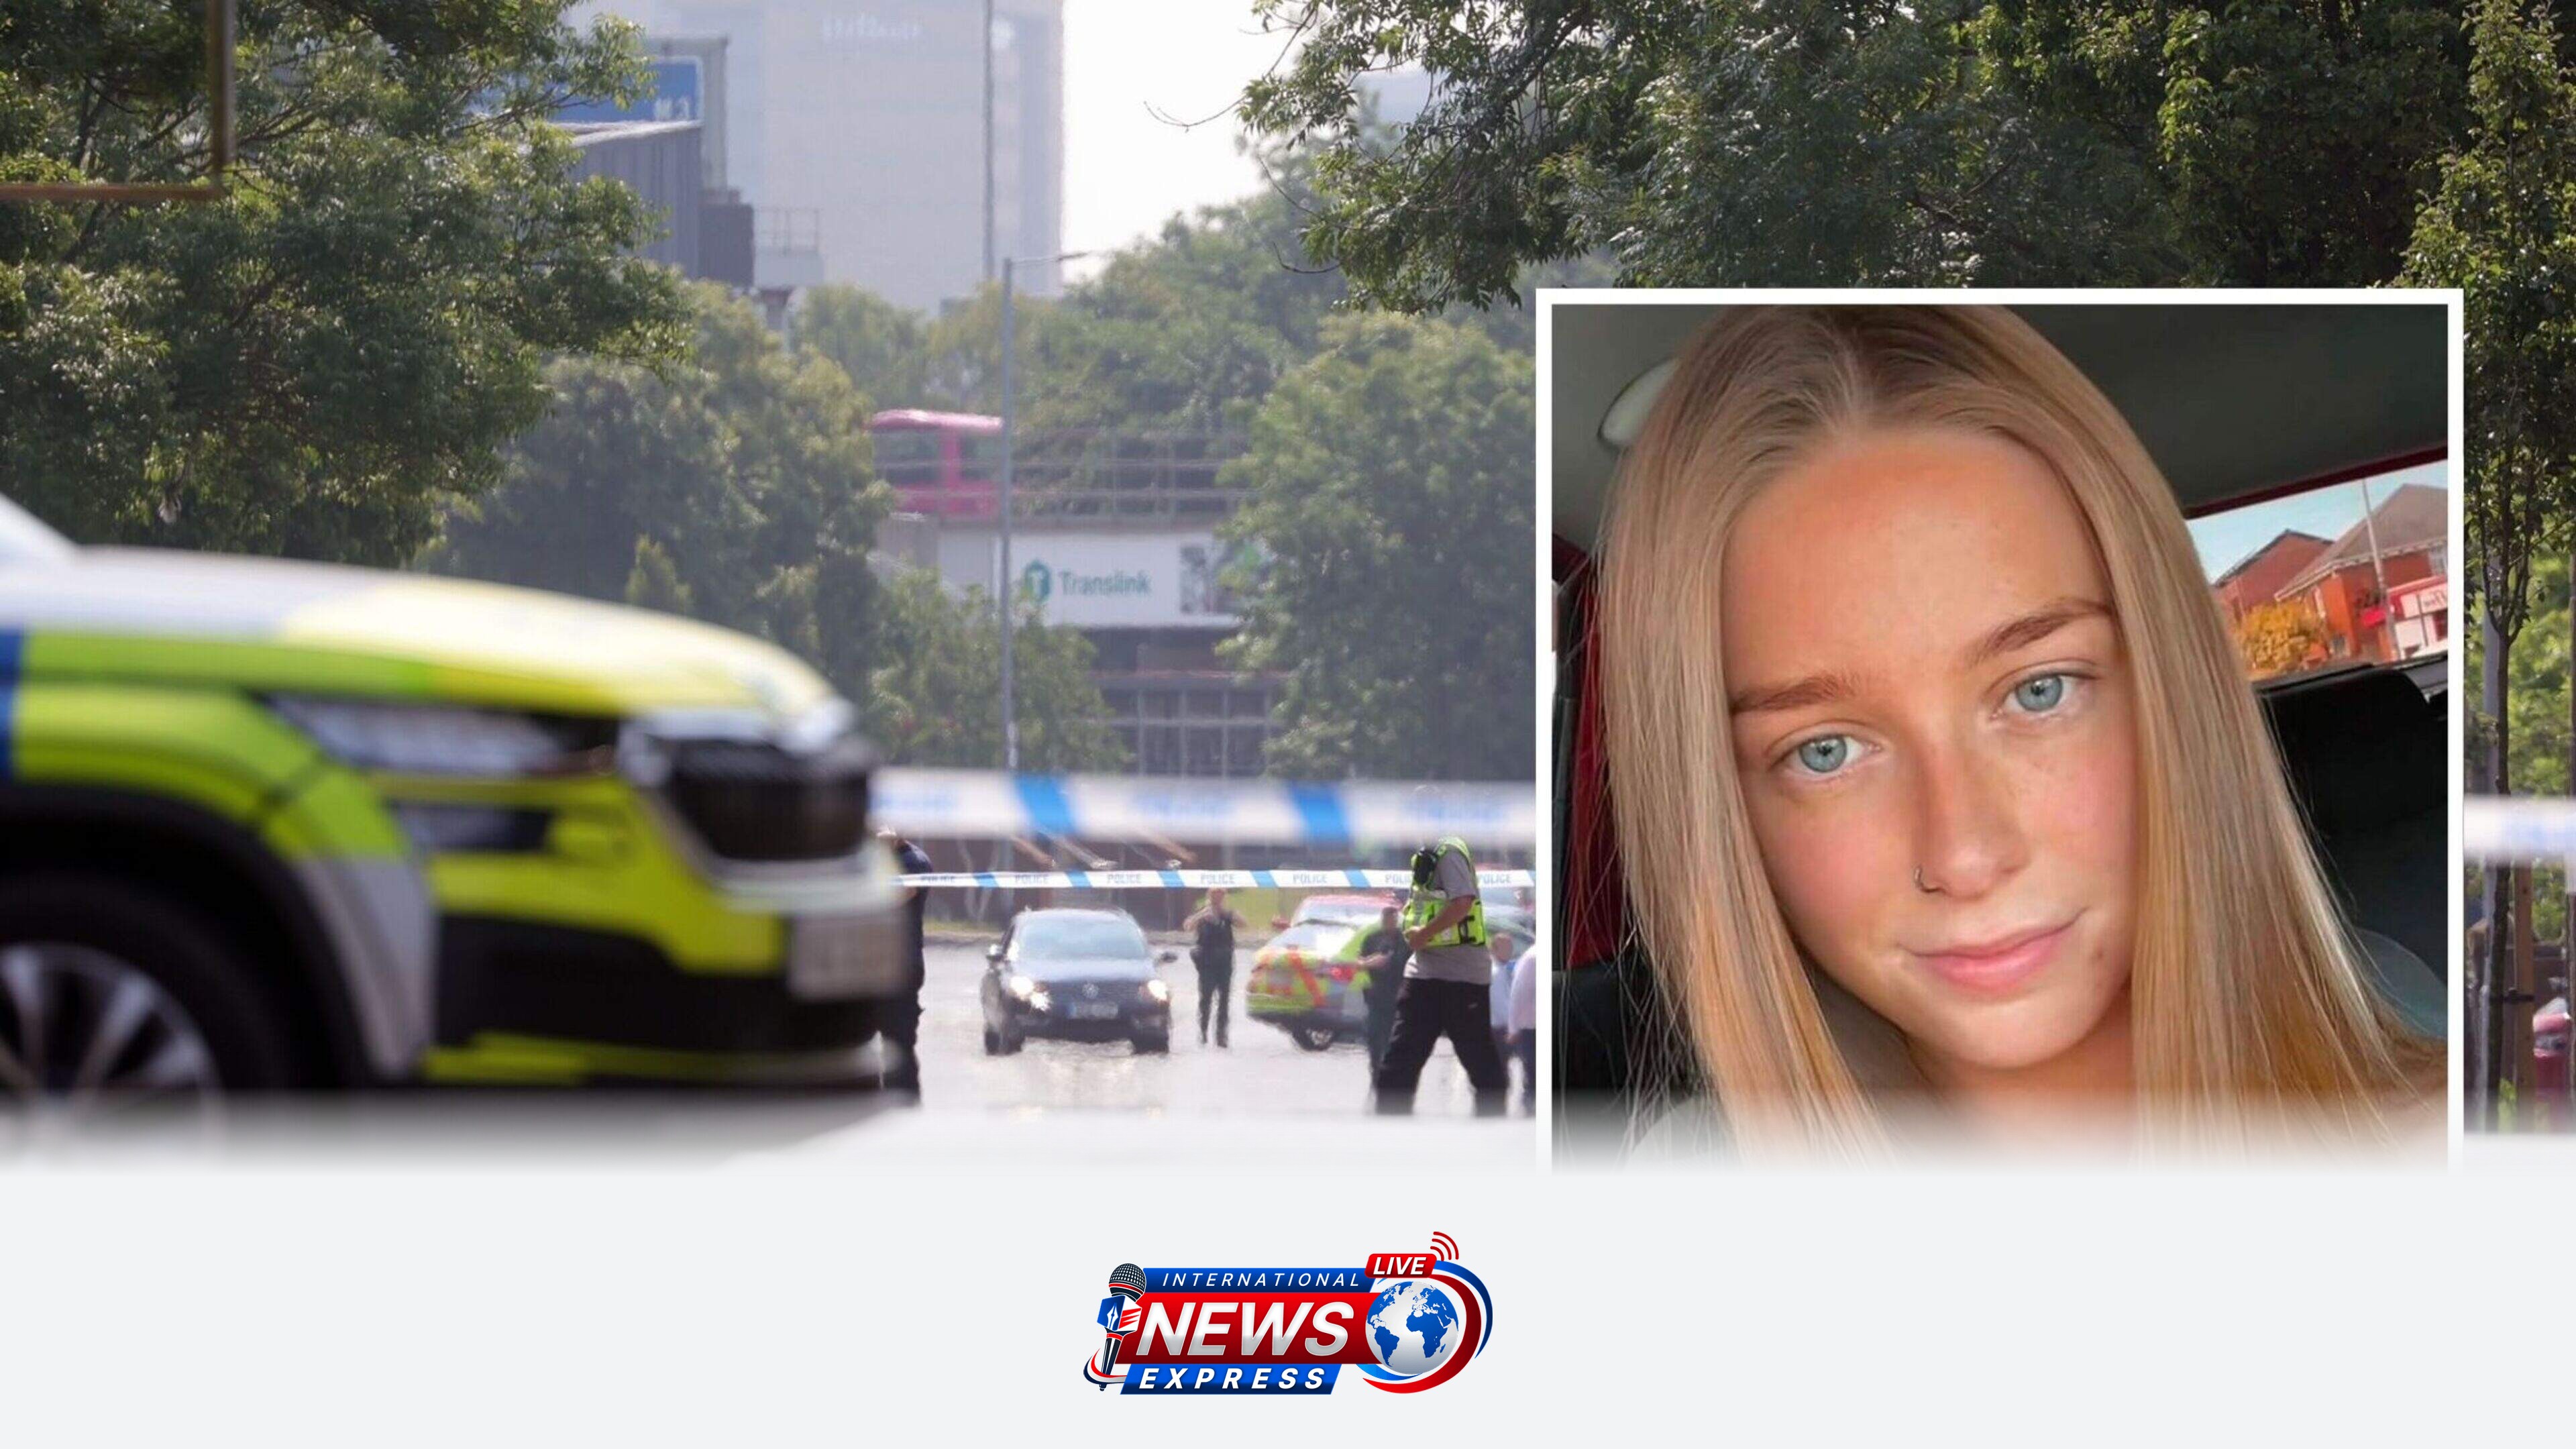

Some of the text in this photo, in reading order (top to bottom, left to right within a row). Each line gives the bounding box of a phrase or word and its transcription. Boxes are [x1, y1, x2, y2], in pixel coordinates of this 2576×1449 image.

[1058, 570, 1152, 595] Translink
[1015, 874, 1049, 883] POLICE
[1107, 873, 1141, 884] POLICE
[1201, 873, 1235, 884] POLICE
[1293, 873, 1327, 883] POLICE
